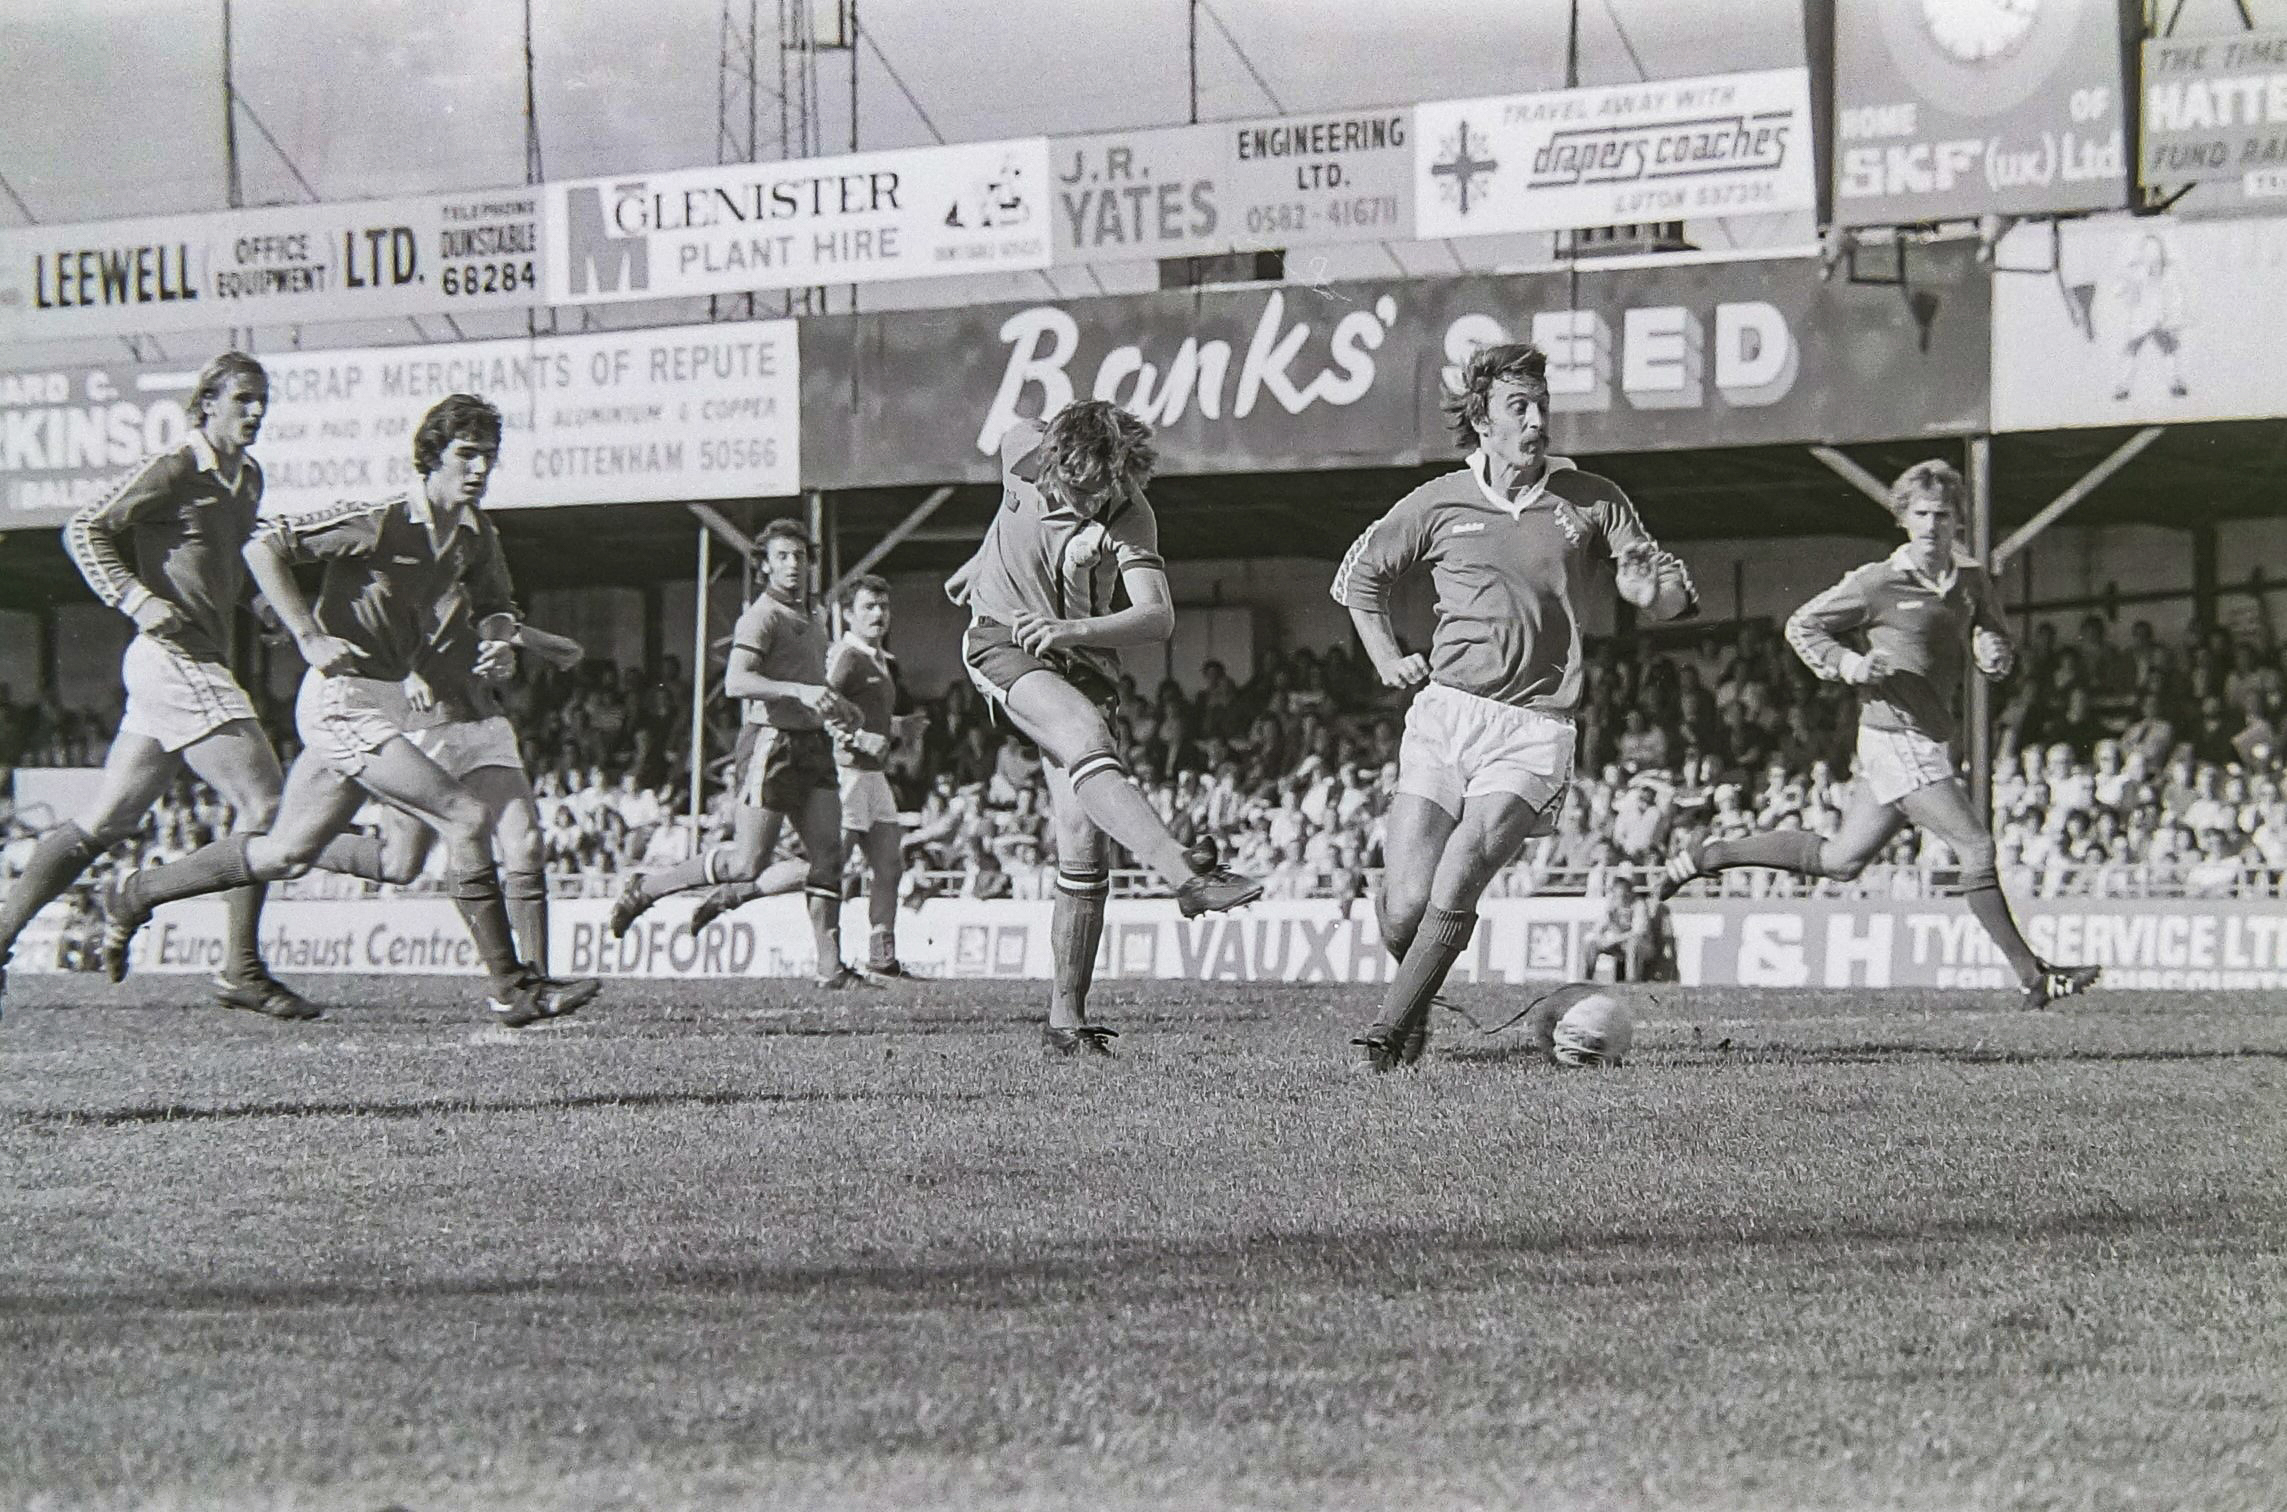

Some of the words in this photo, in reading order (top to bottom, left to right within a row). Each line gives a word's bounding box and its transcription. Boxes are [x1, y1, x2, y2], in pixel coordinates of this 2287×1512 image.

[2158, 45, 2211, 72] THE
[1502, 99, 1588, 126] TRAVEL
[1598, 91, 1666, 116] AWAY
[1675, 84, 1737, 109] WITH
[1840, 102, 1918, 139] HOME
[2068, 86, 2111, 122] OF
[1238, 117, 1405, 160] ENGINEERING
[2150, 141, 2229, 172] FUND
[1297, 162, 1351, 190] LTD.
[1839, 139, 1984, 198] SKF
[2062, 128, 2126, 181] Ltd
[615, 170, 900, 238] GLENISTER
[1060, 178, 1218, 248] YATES
[1614, 188, 1686, 213] LUTON
[234, 233, 309, 265] OFFICE
[344, 225, 425, 289] LTD.
[440, 222, 537, 259] DUNSTABLE
[679, 235, 795, 273] PLANT
[813, 227, 900, 262] HIRE
[32, 243, 198, 310] LEEWELL
[215, 262, 327, 300] EQUIPMENT
[441, 259, 537, 296] 68284
[0, 372, 71, 405] ARD
[267, 365, 364, 405] SCRAP
[381, 351, 571, 398] MERCHANTS
[591, 349, 631, 387] OF
[650, 341, 777, 383] REPUTE
[0, 399, 188, 471] KINSO
[265, 457, 373, 490] BALDOCK
[532, 440, 684, 480] COTTENHAM
[160, 922, 224, 967] Euro
[572, 921, 756, 974] BEDFORD
[1672, 913, 1726, 987] T
[1736, 913, 1811, 987] &
[1823, 913, 1894, 988] H
[1906, 914, 2012, 967] TYR
[2027, 914, 2218, 968] SERVICE
